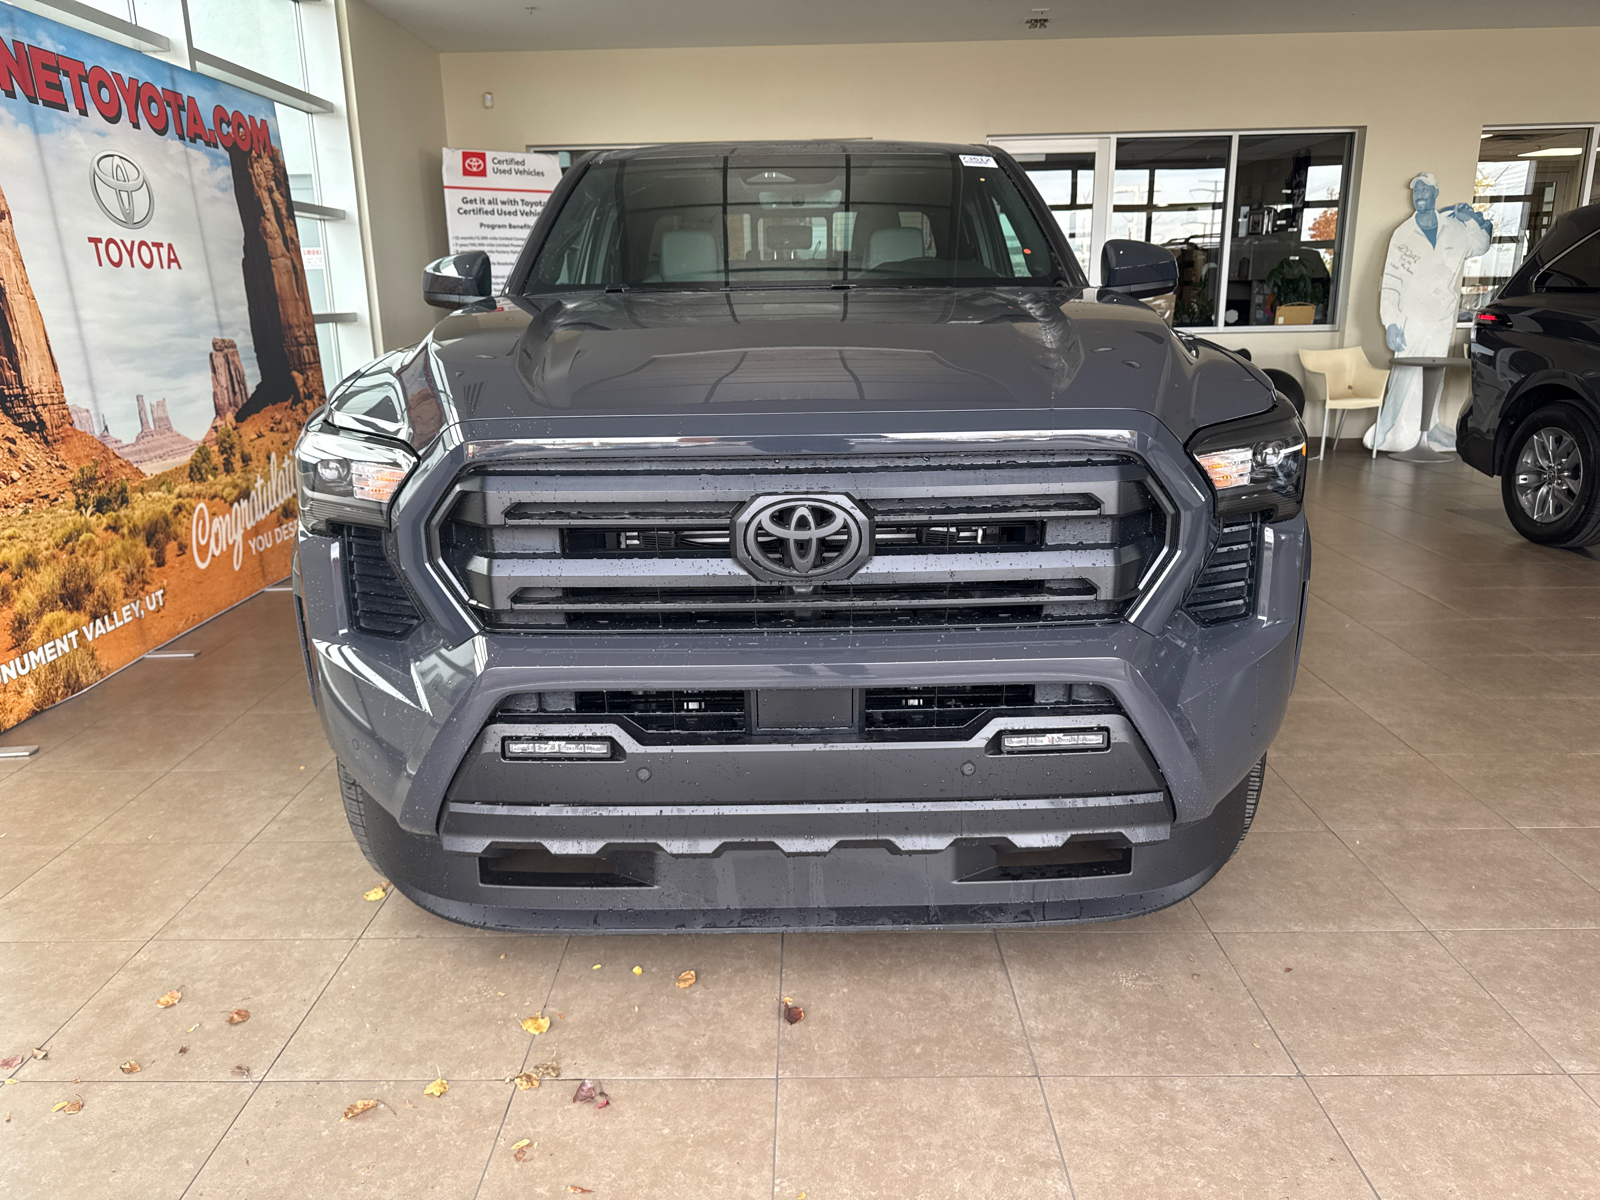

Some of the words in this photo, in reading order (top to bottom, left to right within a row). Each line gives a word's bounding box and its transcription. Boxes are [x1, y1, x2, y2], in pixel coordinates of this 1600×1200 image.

[492, 157, 525, 166] Certified
[492, 167, 512, 175] Used
[514, 168, 545, 177] Vehicles
[461, 196, 478, 205] Get
[479, 197, 486, 205] it
[487, 197, 498, 206] all
[500, 198, 519, 207] with
[457, 207, 495, 216] Certified
[496, 209, 518, 217] Used
[519, 209, 540, 217] Vehic
[87, 236, 182, 270] TOYOTA
[191, 449, 297, 571] Congratulati
[248, 531, 273, 555] YOU
[0, 629, 79, 685] NUMENT
[82, 600, 145, 642] VALLEY,
[146, 589, 165, 611] UT
